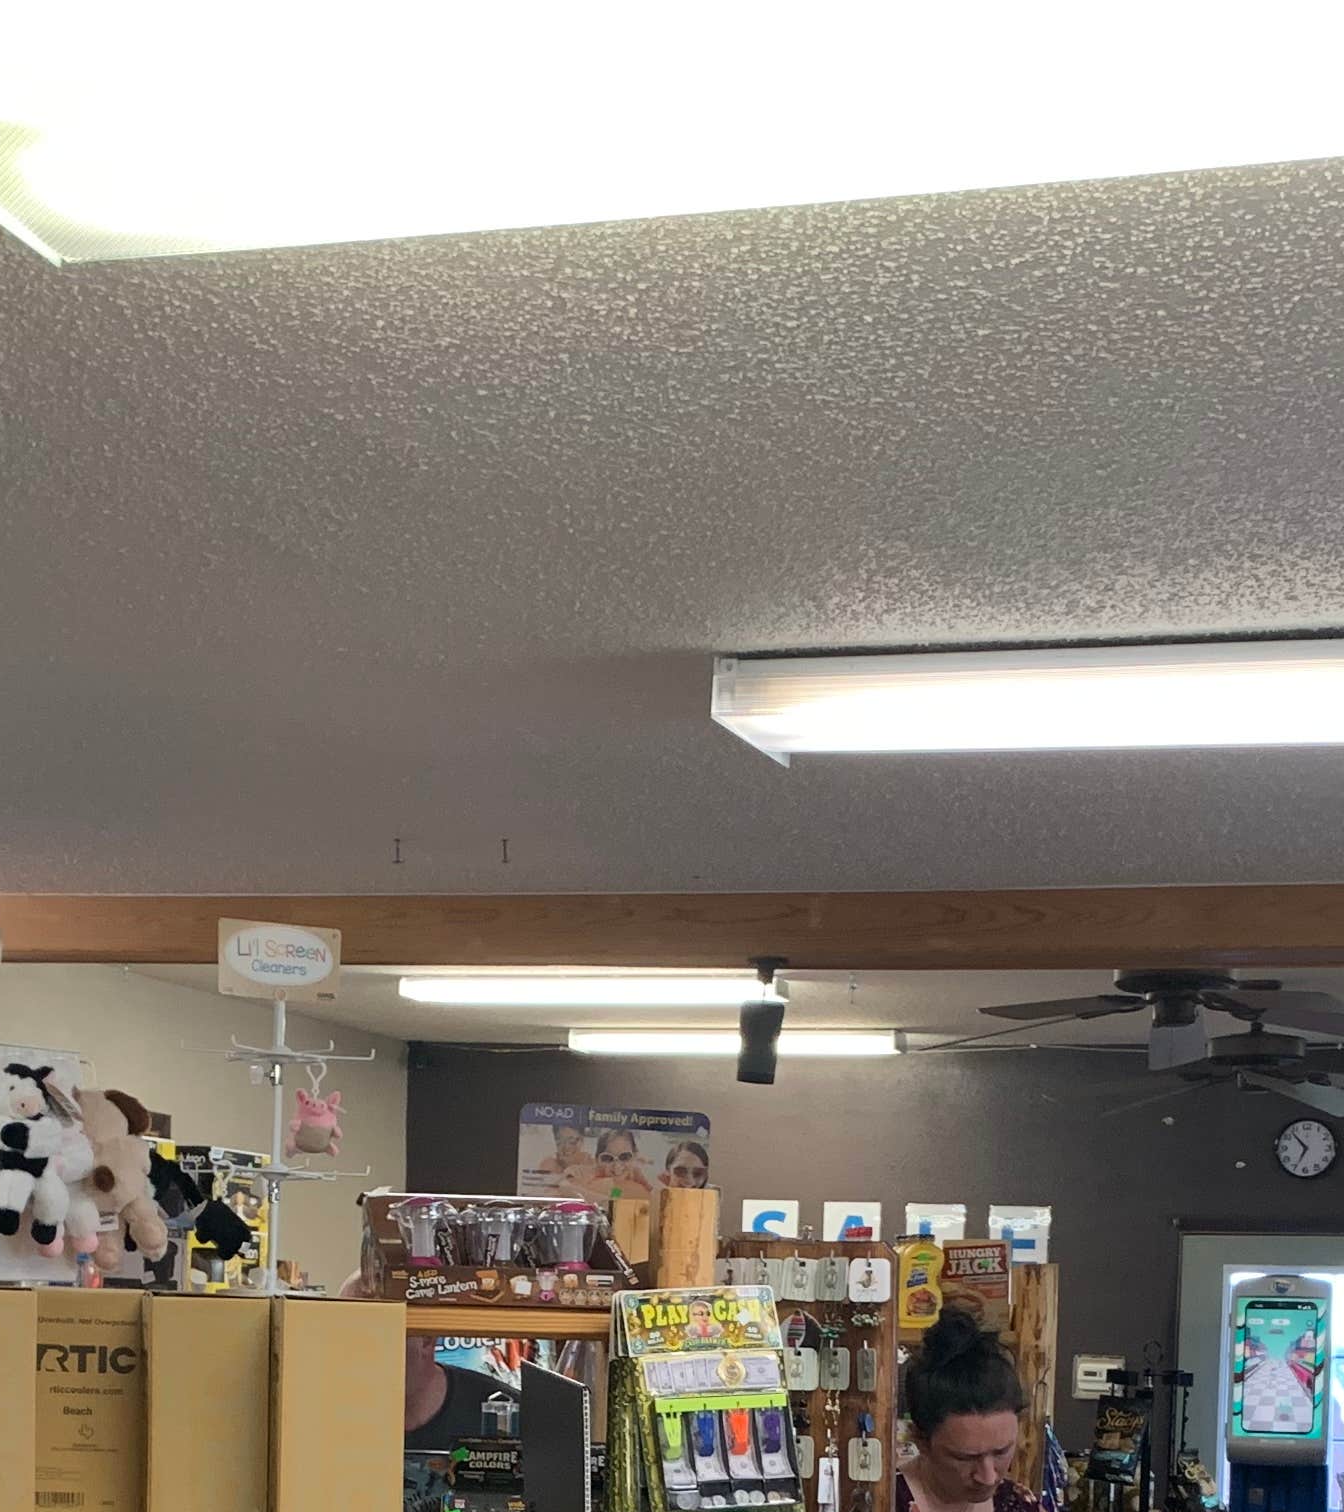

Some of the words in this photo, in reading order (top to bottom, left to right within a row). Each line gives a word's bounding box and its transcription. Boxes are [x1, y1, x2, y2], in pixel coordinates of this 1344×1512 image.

[251, 959, 307, 977] Cleaners
[588, 1109, 629, 1125] Family
[630, 1112, 694, 1127] Approved!
[948, 1247, 1002, 1259] HUNGRY
[946, 1257, 1004, 1276] JACK
[405, 1288, 435, 1300] Camp
[437, 1280, 479, 1295] Lantern
[640, 1303, 690, 1329] PLAY
[36, 1343, 137, 1375] RTIC
[49, 1385, 125, 1396] rticcoolers.com
[62, 1406, 93, 1416] Beach
[464, 1450, 518, 1464] AMPFIRE
[469, 1460, 511, 1470] COLORS
